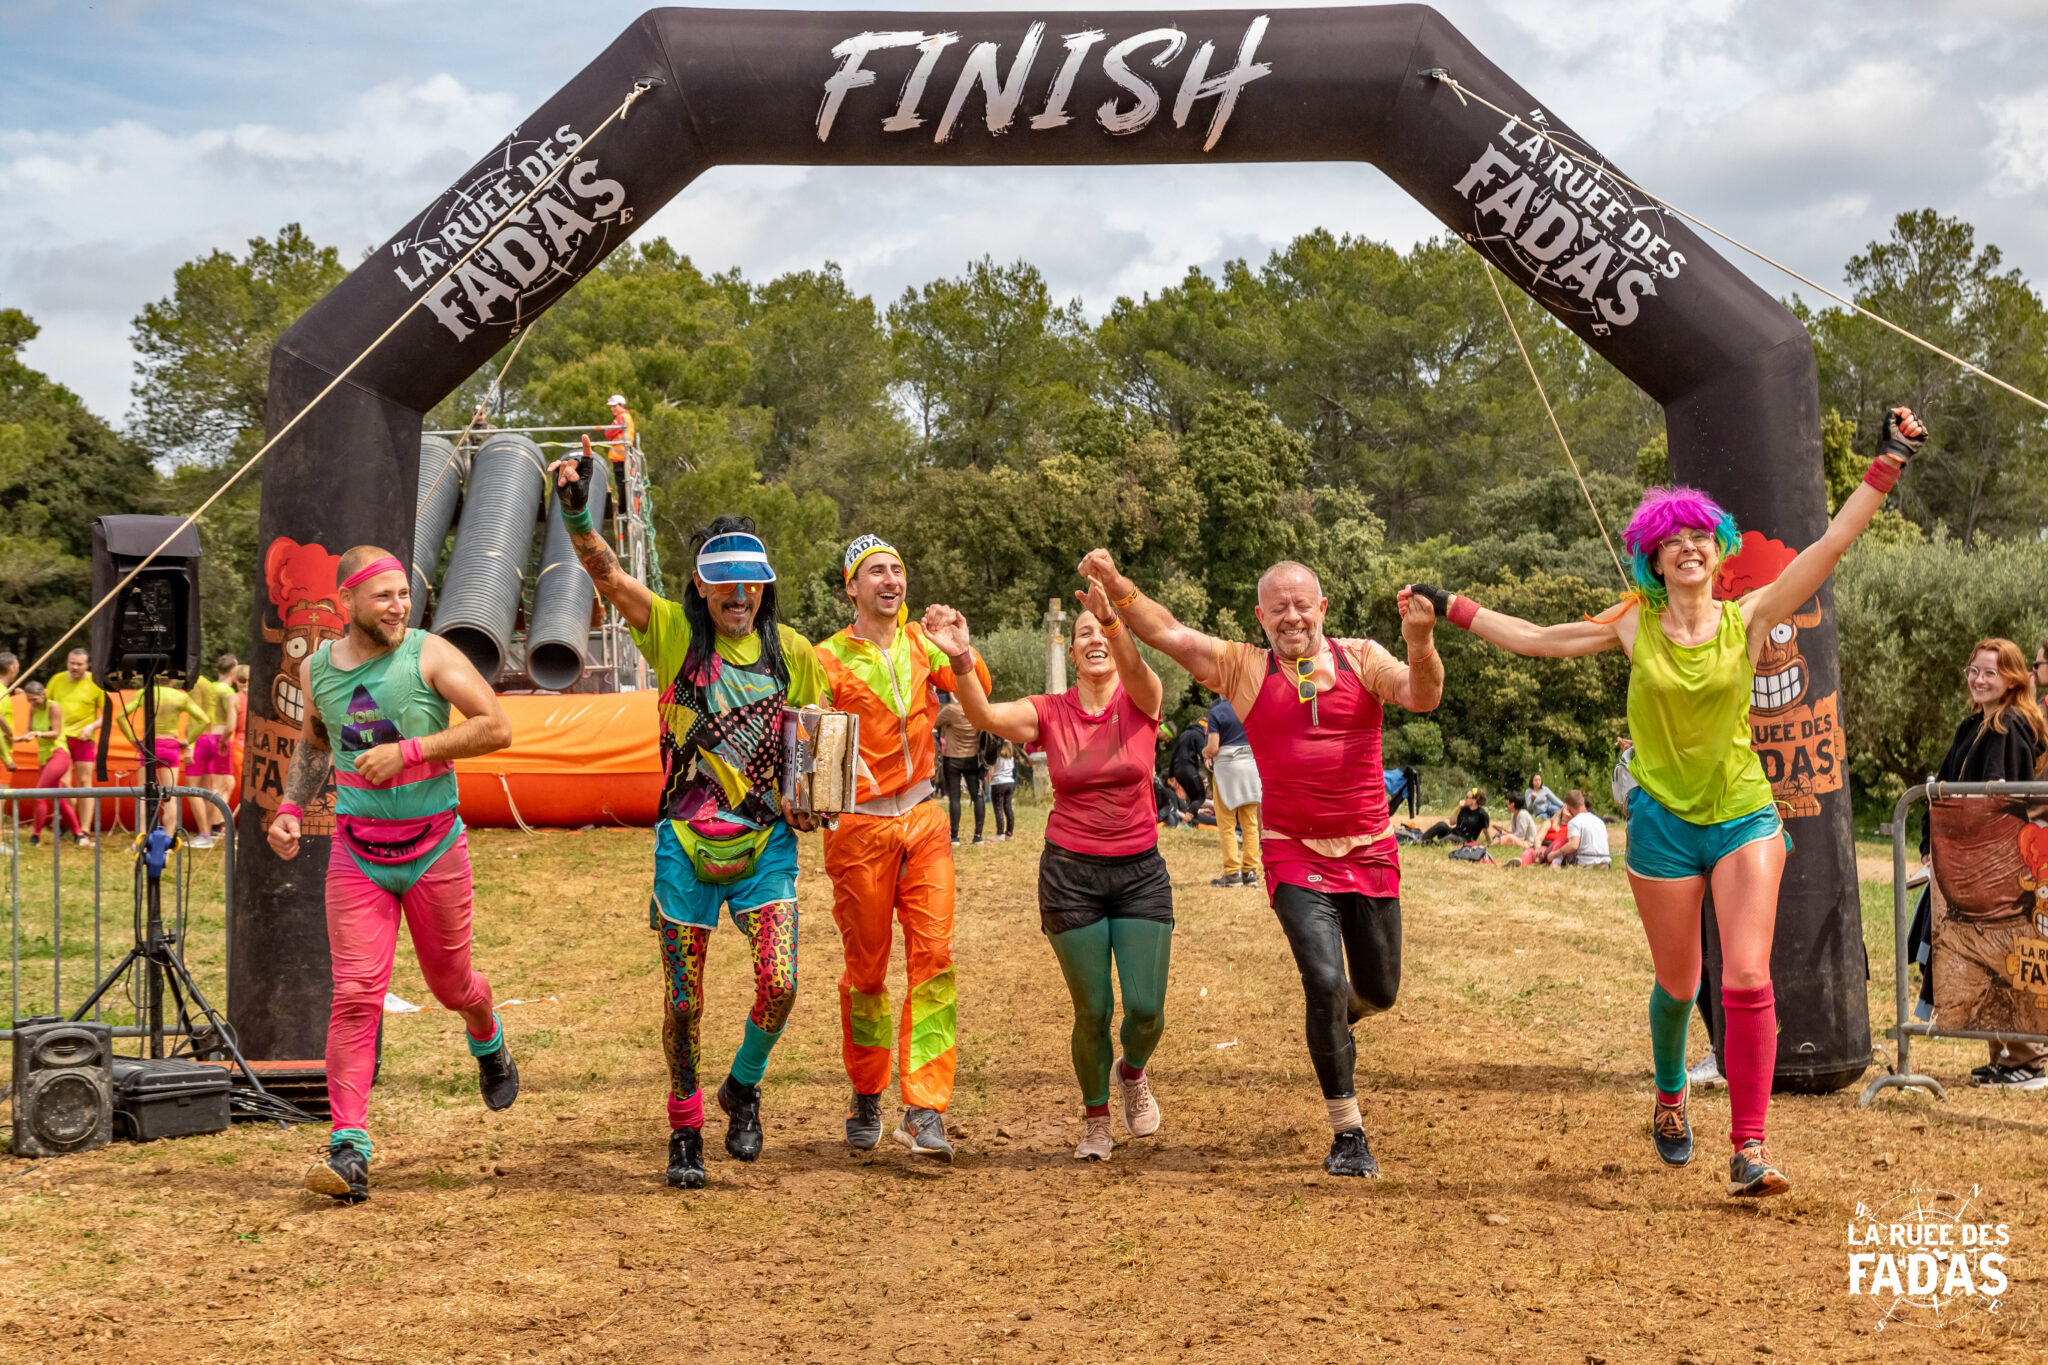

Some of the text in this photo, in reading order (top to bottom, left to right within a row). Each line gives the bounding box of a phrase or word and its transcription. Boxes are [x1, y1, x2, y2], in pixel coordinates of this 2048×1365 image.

[816, 15, 1273, 152] FINISH
[394, 124, 584, 292] LA RUEE DES
[422, 158, 626, 343] FADAS
[1453, 142, 1658, 327] FADAS
[1498, 114, 1687, 279] LA RUEE DES
[253, 728, 271, 752] LA
[1757, 738, 1835, 783] DAS
[1801, 713, 1833, 739] DES
[2021, 944, 2035, 959] LA
